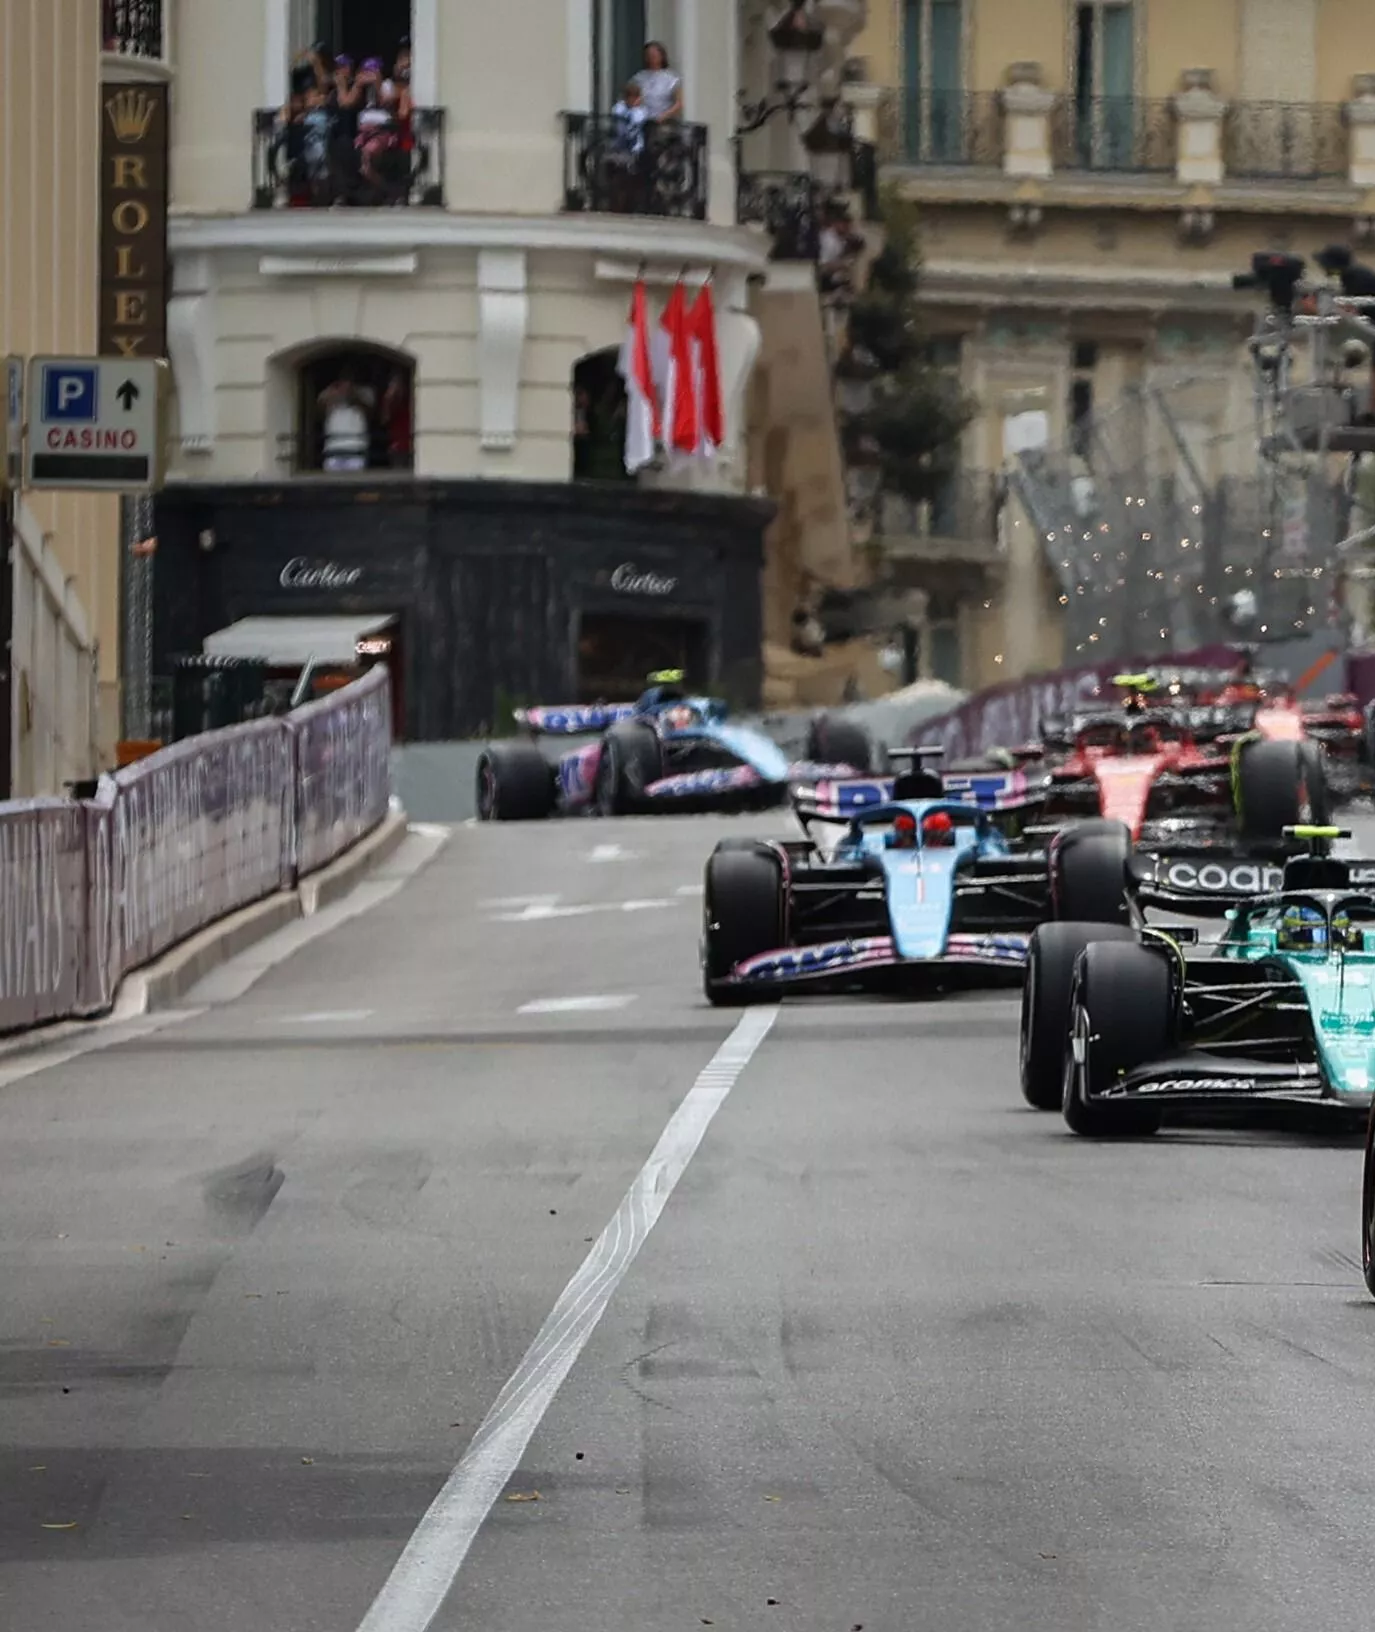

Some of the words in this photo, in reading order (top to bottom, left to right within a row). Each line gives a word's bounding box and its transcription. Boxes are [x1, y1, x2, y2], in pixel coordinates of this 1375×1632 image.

[110, 155, 149, 356] ROLEX
[57, 376, 85, 411] P
[46, 427, 137, 450] CASINO
[279, 555, 362, 588] Cartier
[610, 560, 679, 596] Cartier
